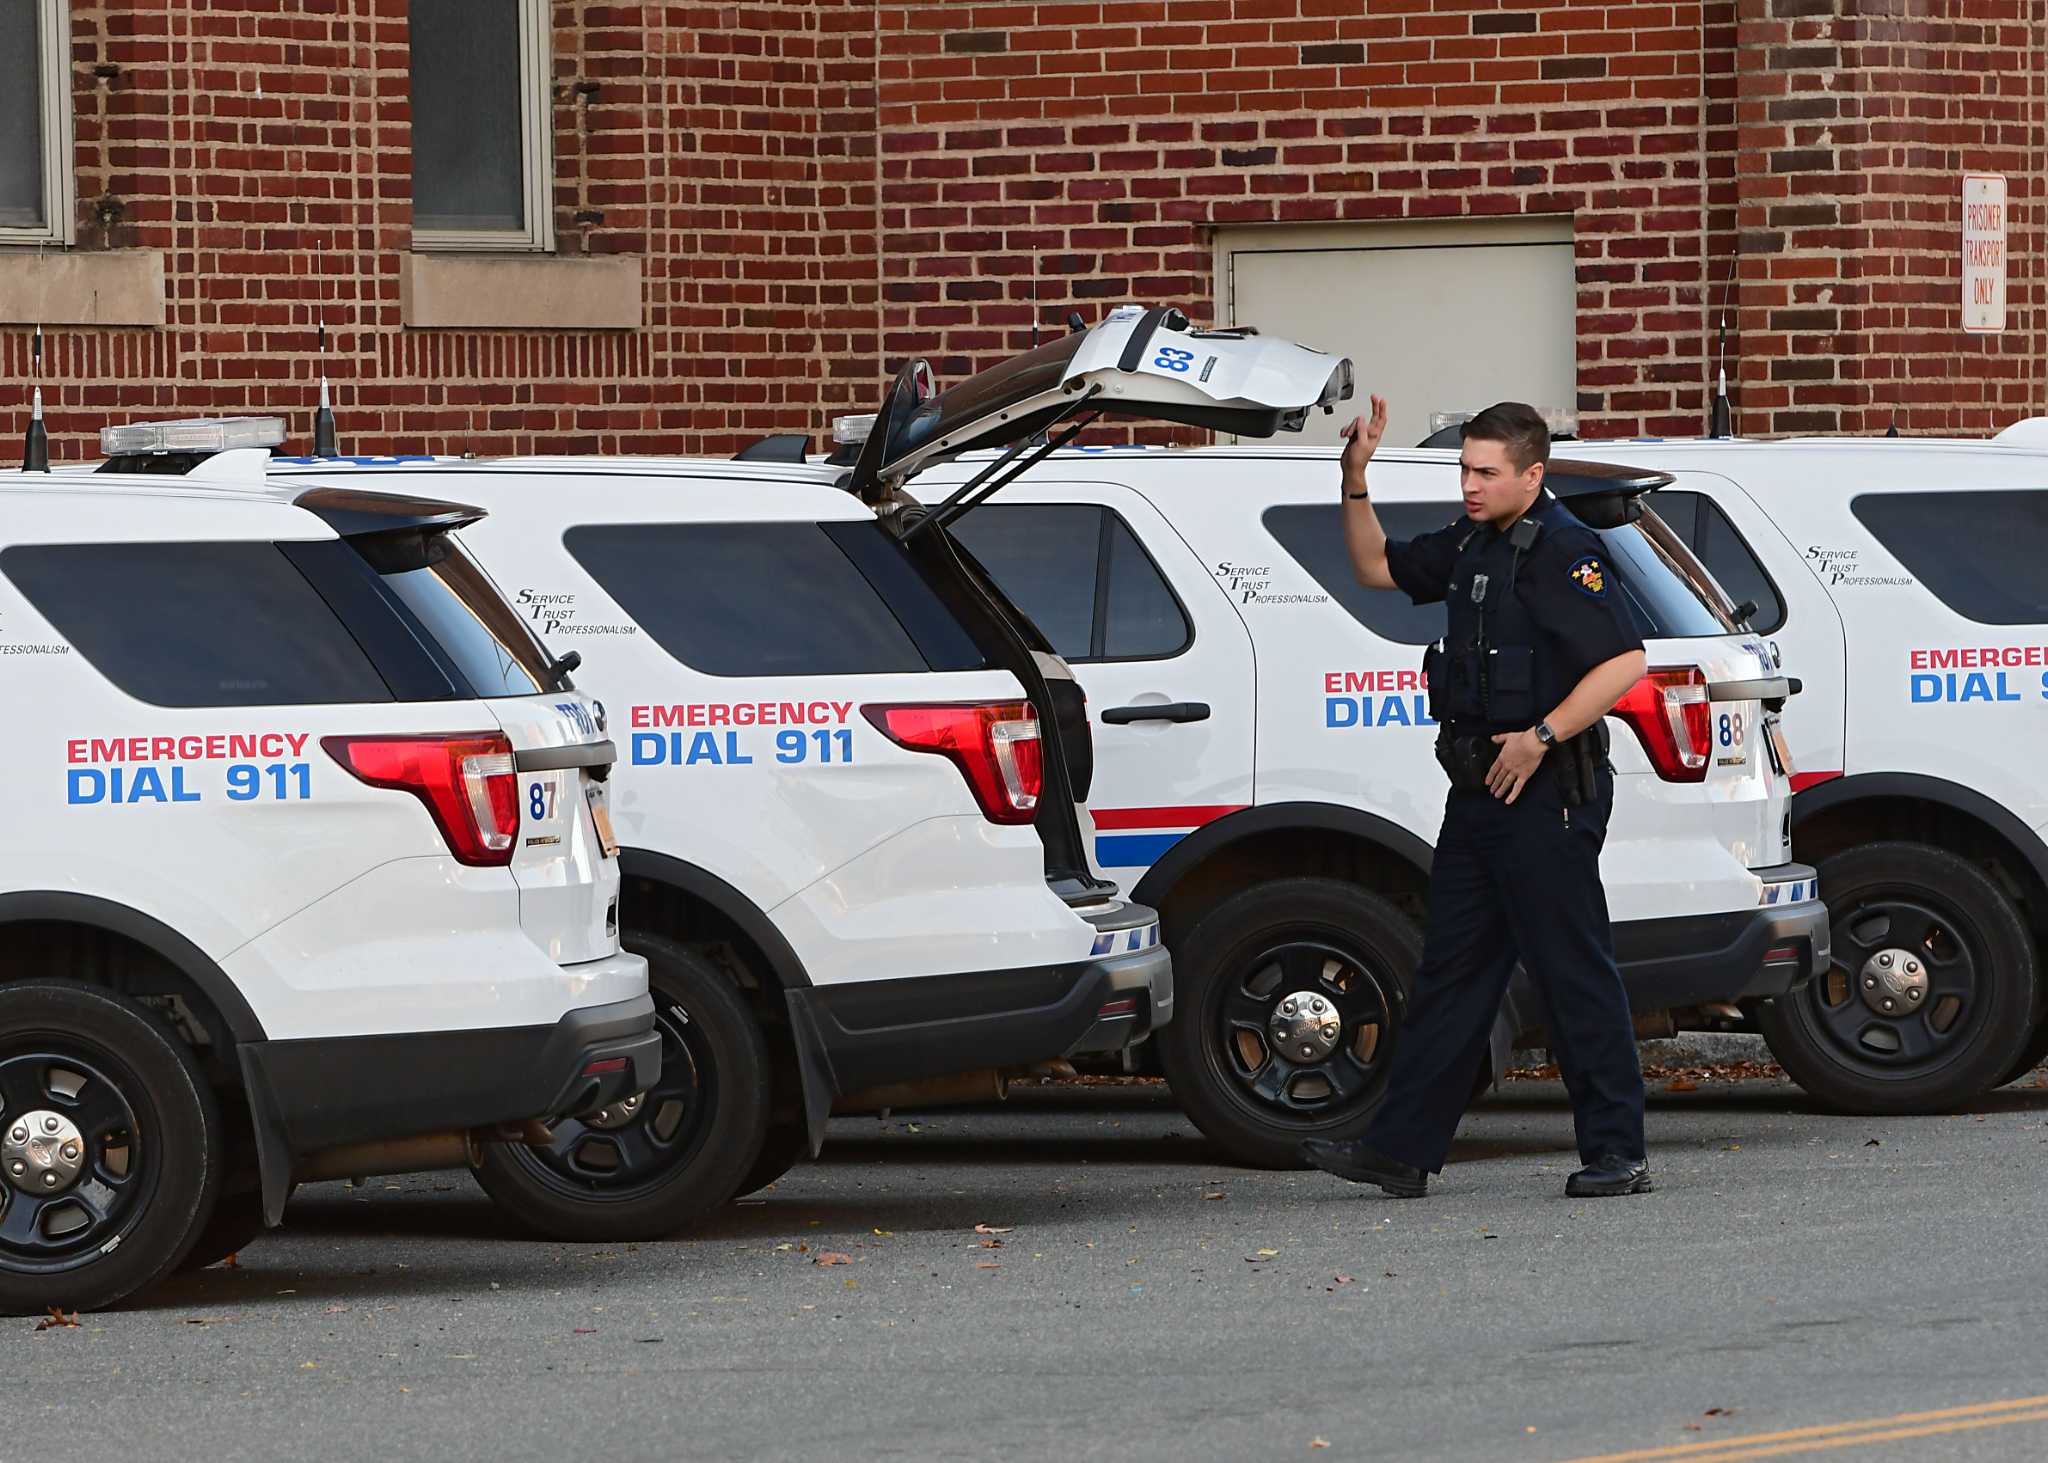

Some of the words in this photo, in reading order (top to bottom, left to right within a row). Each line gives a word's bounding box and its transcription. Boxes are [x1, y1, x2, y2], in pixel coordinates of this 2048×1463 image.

[1967, 204, 2001, 232] PRISONER
[1965, 240, 2003, 267] TRANSPORT
[1974, 278, 1994, 305] ONLY
[1154, 347, 1194, 373] 83
[1910, 672, 2021, 704] DIAL
[631, 702, 853, 727] EMERGENCY
[1326, 695, 1441, 728] DIAL
[1719, 714, 1744, 747] 88
[67, 733, 310, 763] EMERGENCY
[631, 731, 753, 766] DIAL
[776, 729, 853, 764] 911
[67, 766, 201, 805] DIAL
[226, 763, 311, 801] 911
[529, 783, 556, 820] 87
